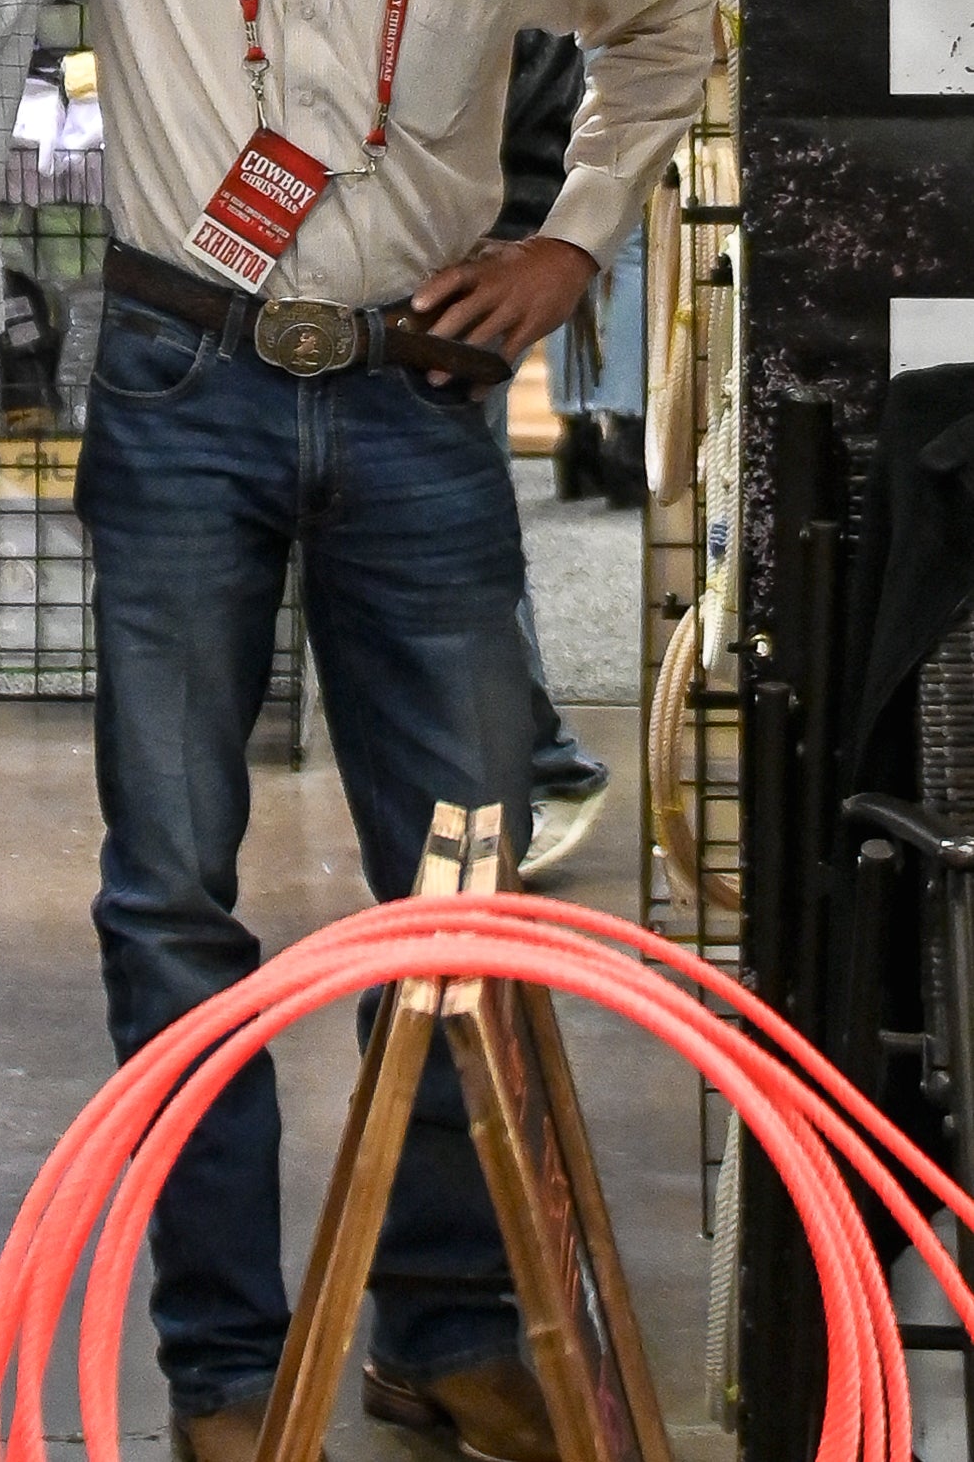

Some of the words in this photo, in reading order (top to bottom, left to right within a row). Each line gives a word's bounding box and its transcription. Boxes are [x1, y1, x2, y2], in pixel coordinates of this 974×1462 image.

[384, 10, 400, 82] CHRISTMAS
[240, 150, 316, 209] COWBOY
[240, 172, 299, 215] CHRISTMAS
[191, 220, 269, 285] EXHIBITOR
